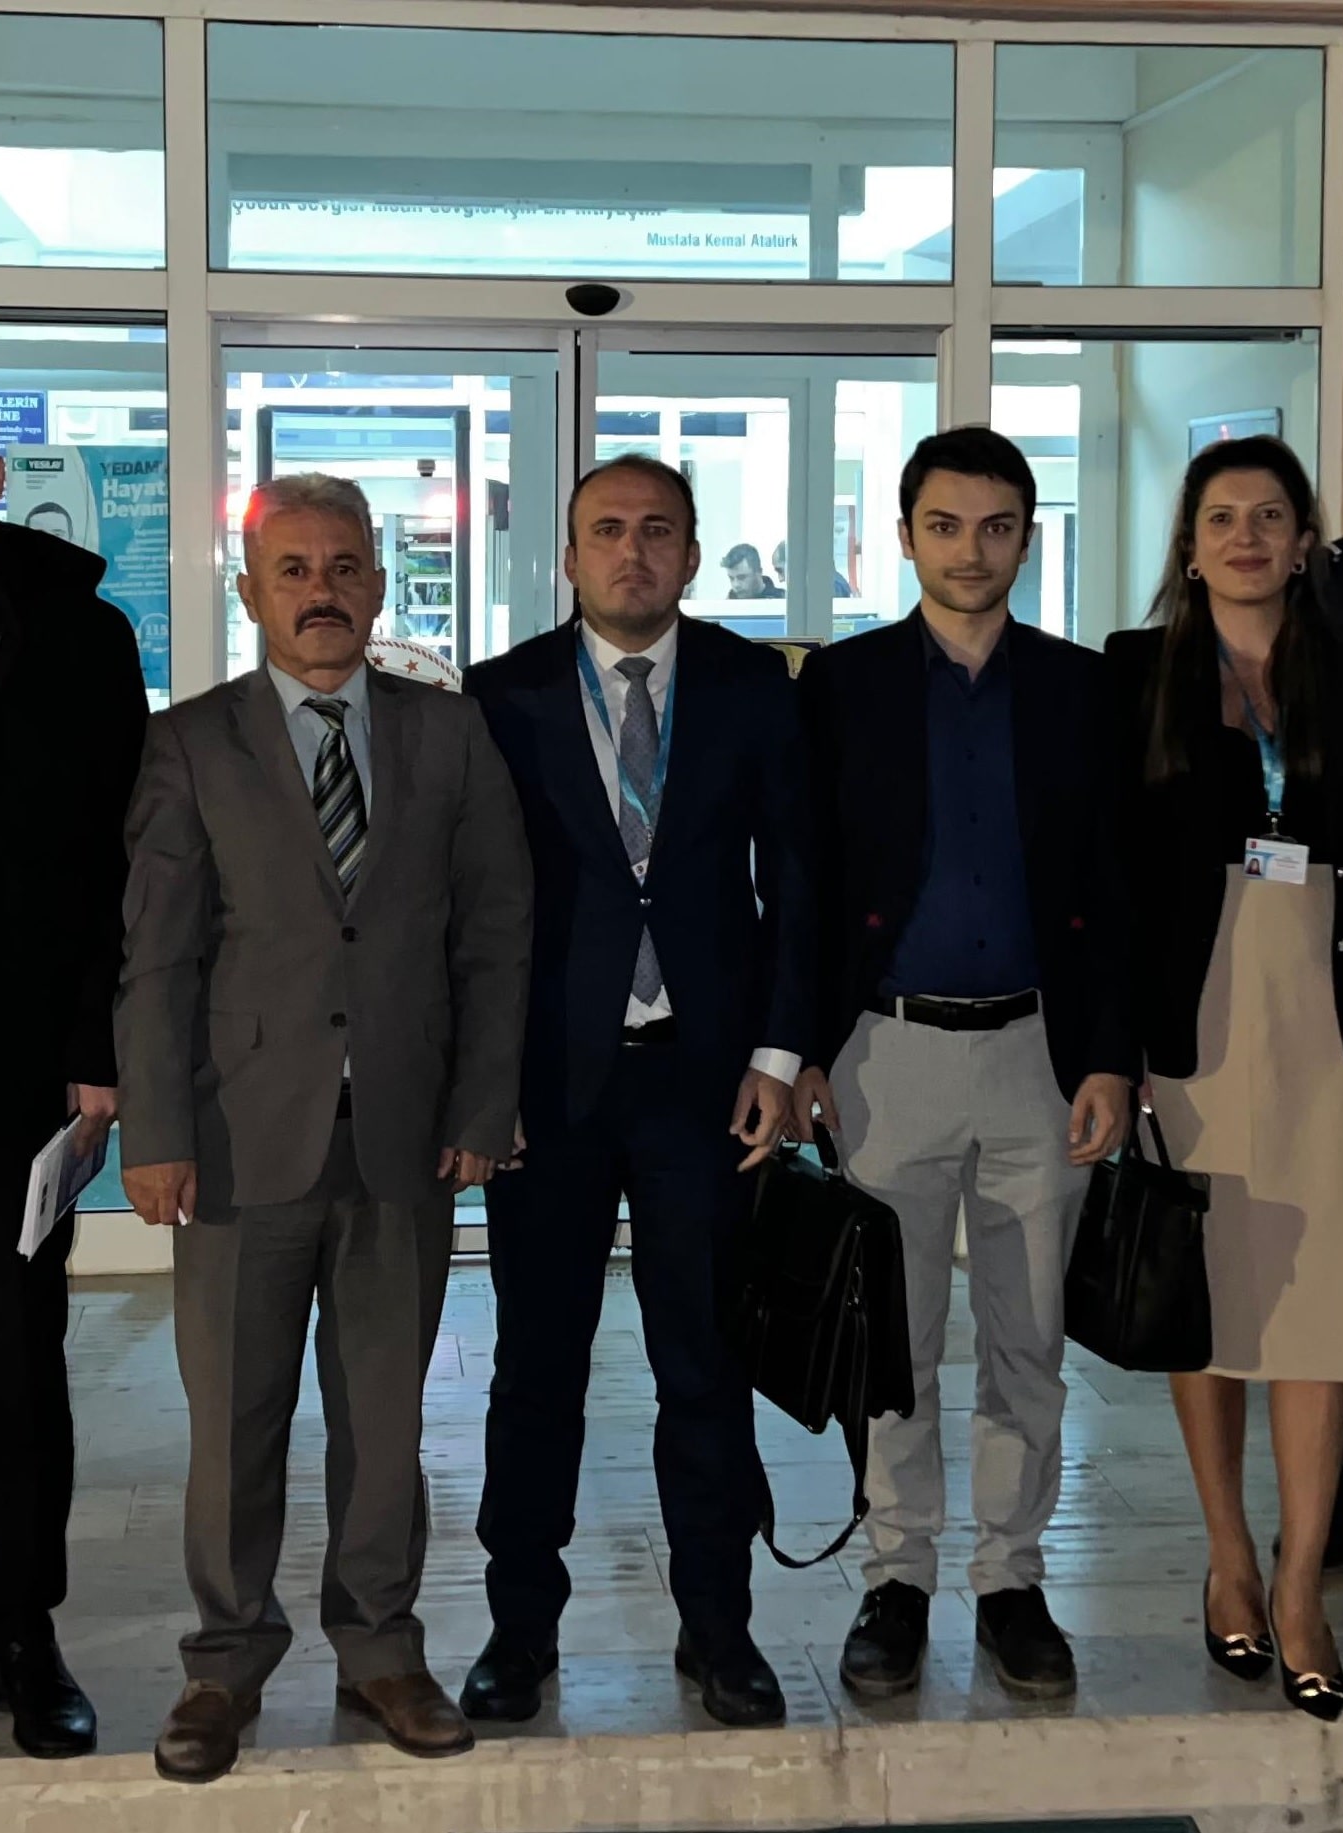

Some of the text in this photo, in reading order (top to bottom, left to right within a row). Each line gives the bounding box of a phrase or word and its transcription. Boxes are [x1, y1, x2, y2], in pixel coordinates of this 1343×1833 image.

[647, 232, 798, 248] Mustafa Kemal Atatürk
[102, 478, 166, 503] Hayat
